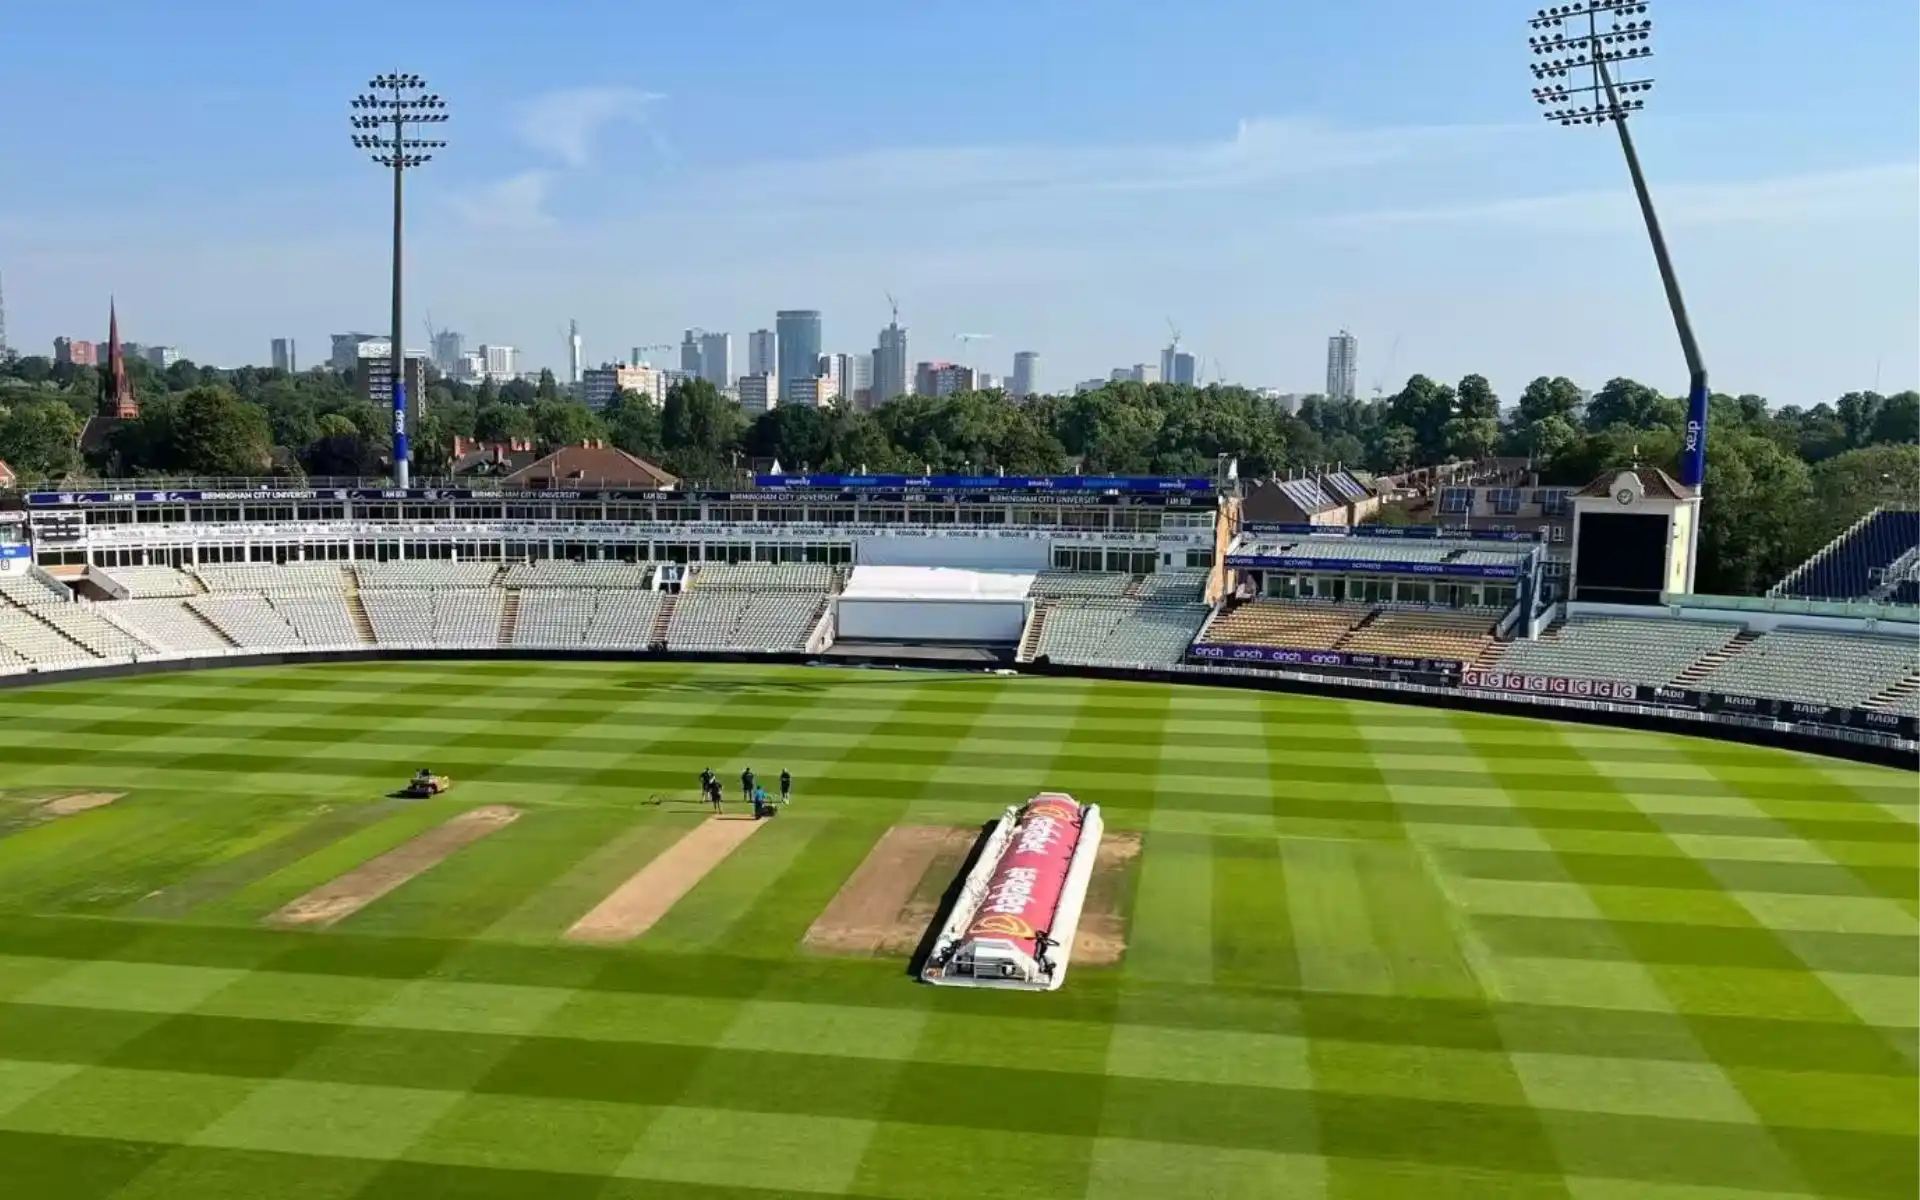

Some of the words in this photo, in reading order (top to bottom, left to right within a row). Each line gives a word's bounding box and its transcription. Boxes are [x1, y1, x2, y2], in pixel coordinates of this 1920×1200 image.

[1685, 420, 1701, 452] drax
[201, 491, 251, 499] BIRMINGHAM
[253, 491, 271, 499] CITY
[273, 491, 317, 499] UNIVERSITY
[471, 491, 520, 499] BIRMINGHAM
[521, 491, 537, 499] CITY
[538, 491, 581, 499] UNIVERSITY
[779, 493, 794, 501] CITY
[797, 493, 840, 501] UNIVERSITY
[989, 495, 1037, 503] BIRMINGHAM
[1038, 495, 1055, 503] CITY
[1056, 495, 1100, 504] UNIVERSITY
[1284, 559, 1313, 567] scrivens
[1195, 647, 1224, 657] cinch
[1233, 649, 1262, 659] cinch
[1273, 650, 1302, 662] cinch
[1311, 653, 1341, 665] cinch
[1463, 672, 1477, 685] IG
[1483, 672, 1500, 687] IG
[1506, 675, 1521, 689] IG
[1529, 676, 1543, 689] IG
[1550, 678, 1566, 692] IG
[1572, 679, 1588, 693] IG
[1595, 682, 1610, 696] IG
[1616, 684, 1632, 698] IG
[1724, 695, 1757, 706] RADO
[1792, 703, 1825, 714] RADO
[1866, 713, 1899, 725] RADO
